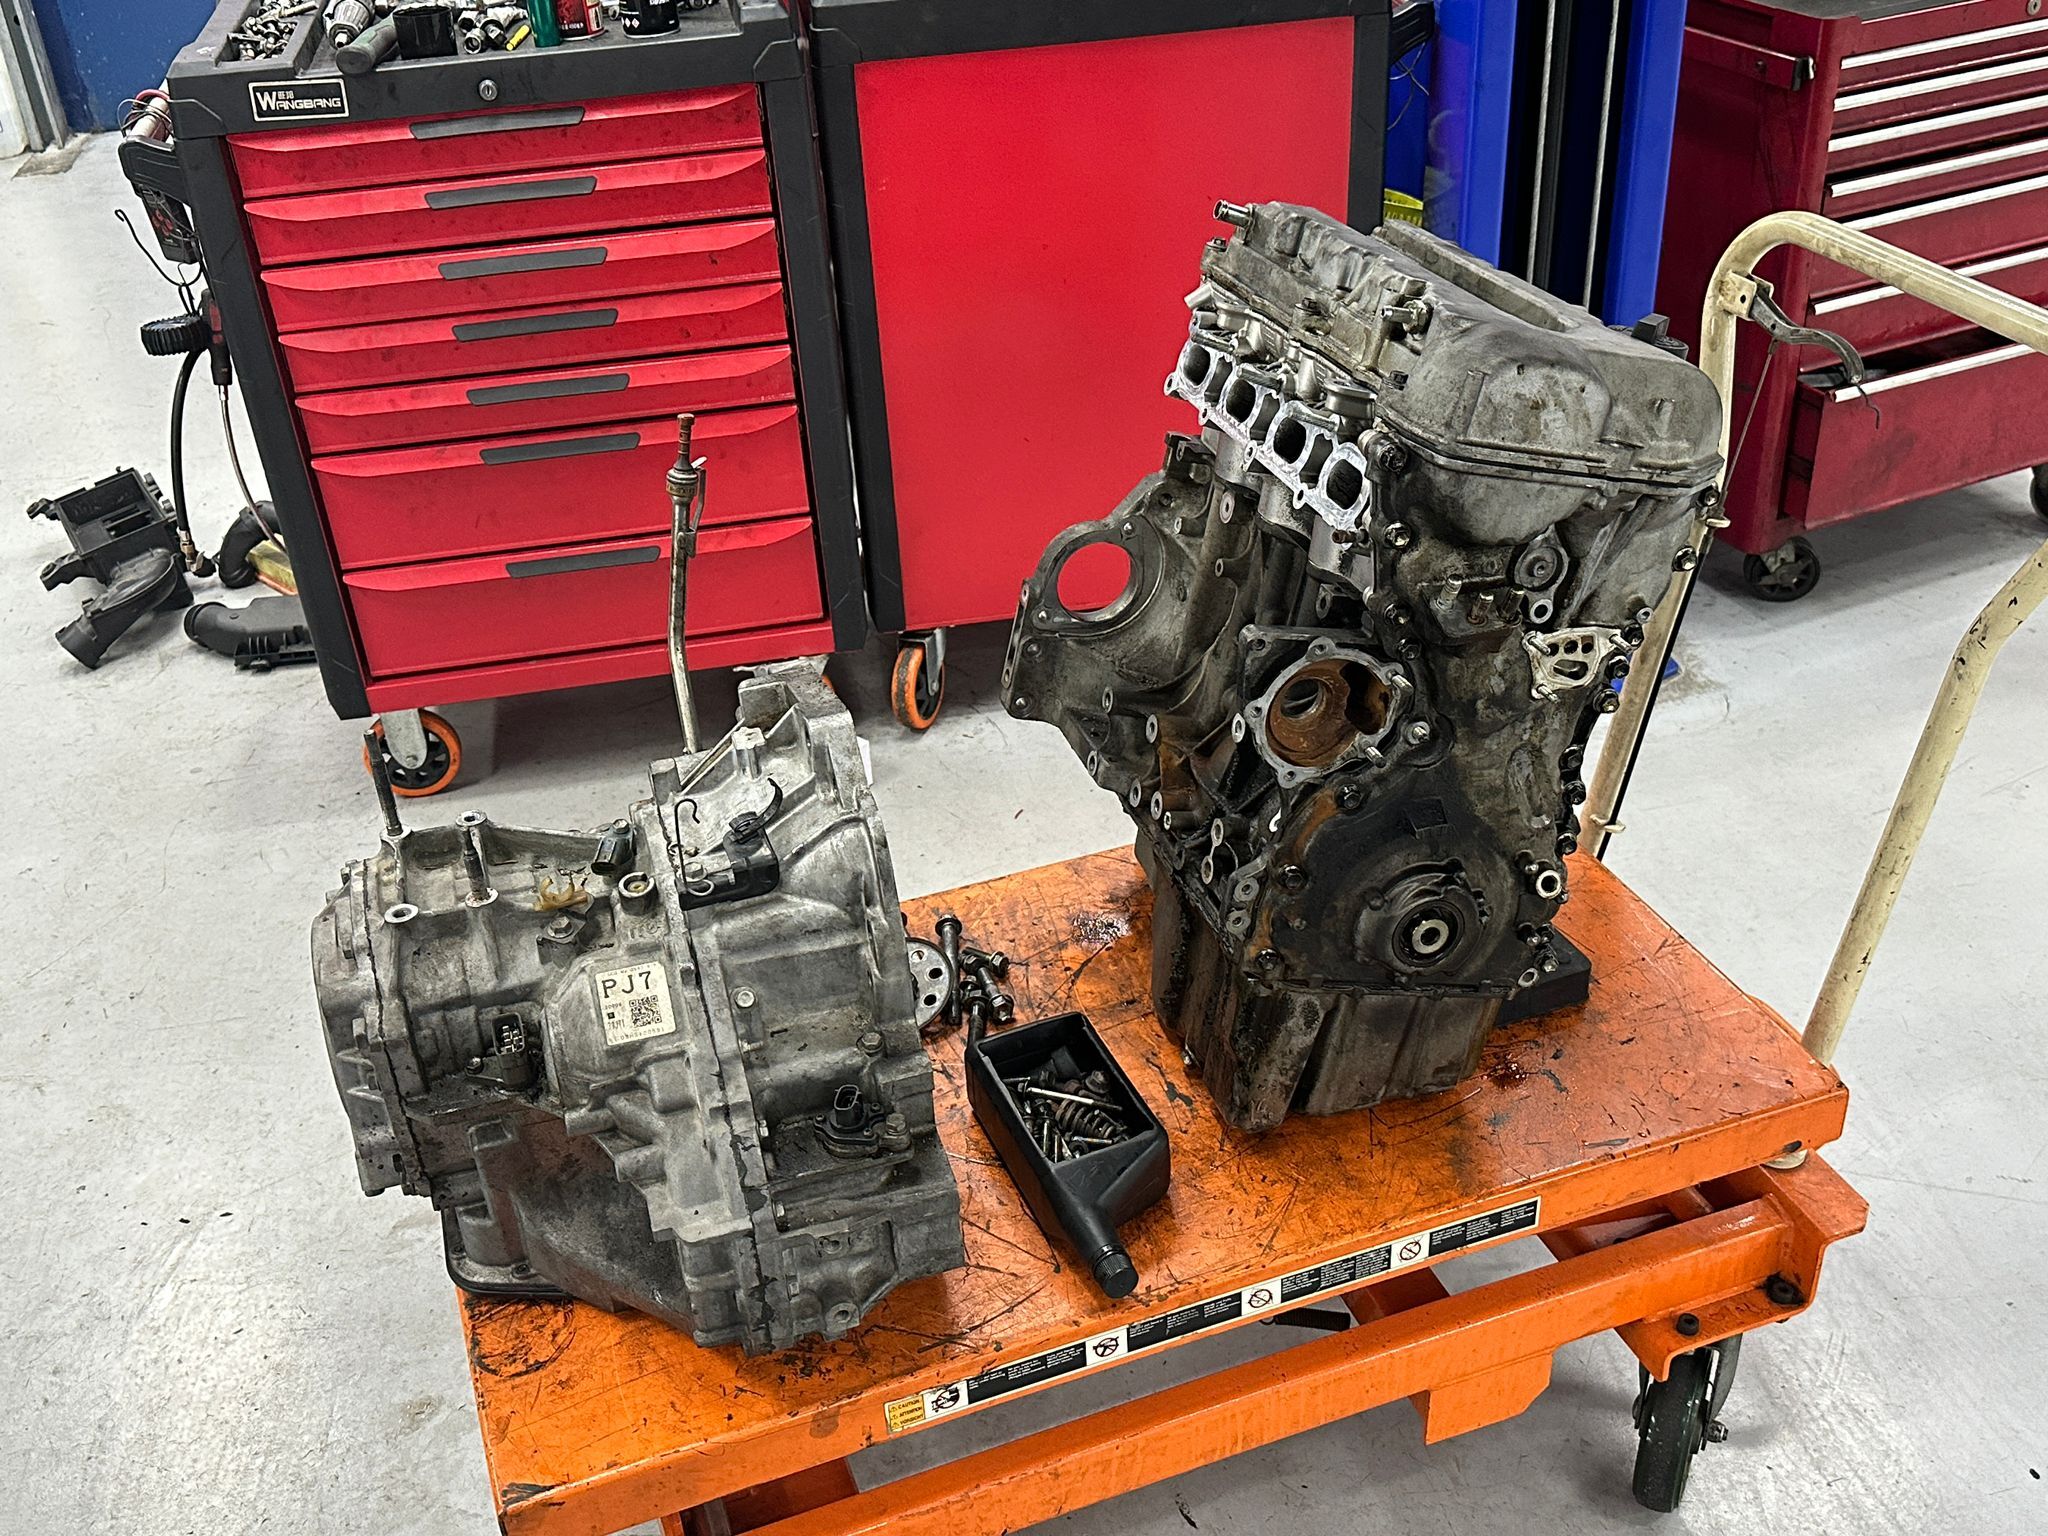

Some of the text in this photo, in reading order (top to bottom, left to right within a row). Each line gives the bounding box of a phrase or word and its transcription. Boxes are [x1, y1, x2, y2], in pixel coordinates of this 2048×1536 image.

[255, 92, 342, 111] WANGBANG
[601, 971, 652, 998] PJ7
[898, 1399, 920, 1409] CAUTION
